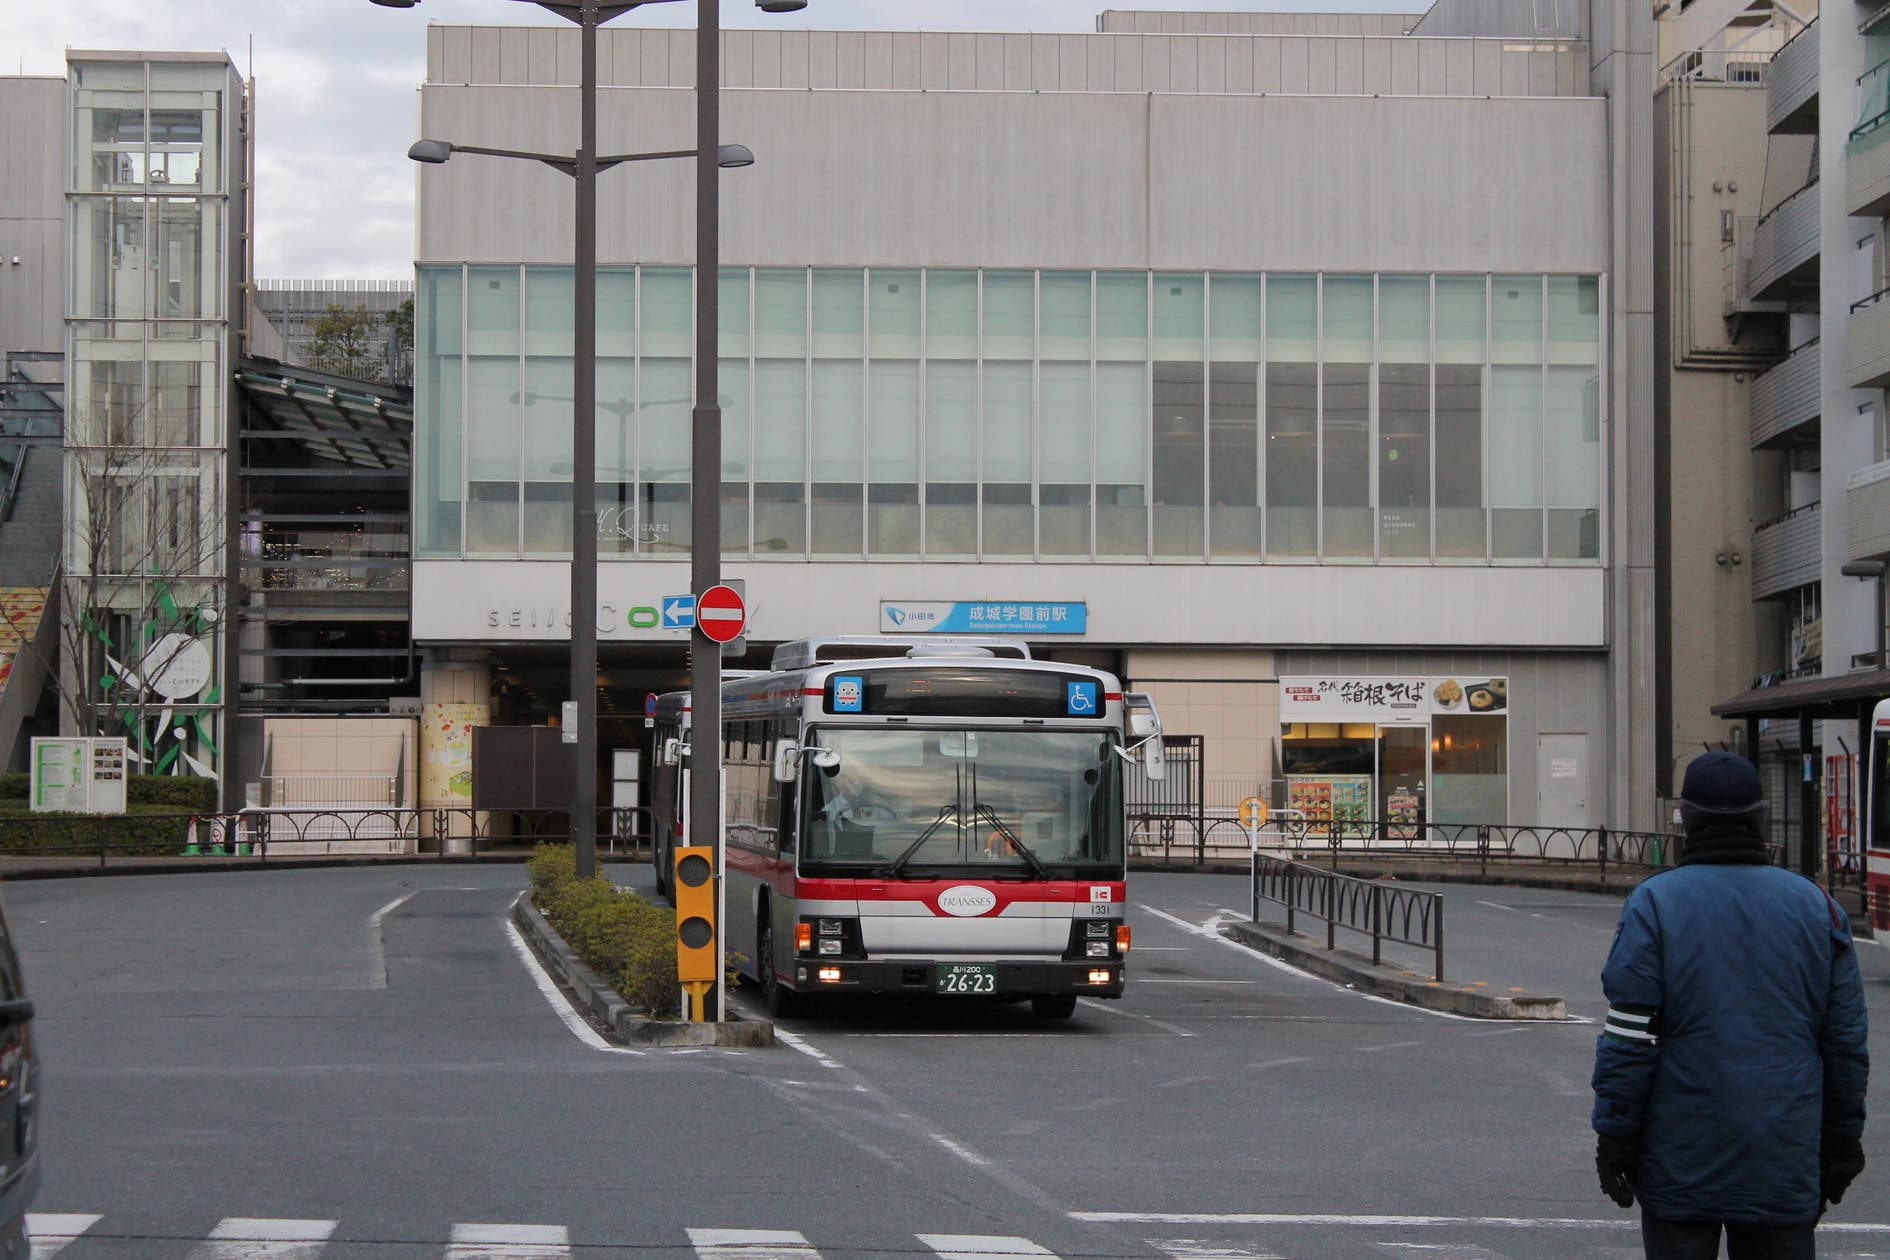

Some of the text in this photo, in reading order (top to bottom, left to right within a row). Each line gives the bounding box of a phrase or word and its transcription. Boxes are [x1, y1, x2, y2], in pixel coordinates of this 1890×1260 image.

[640, 523, 669, 532] CAFE
[596, 603, 761, 634] COY
[908, 612, 936, 621] 小田急
[969, 606, 1068, 621] 成城学園前駅
[1340, 681, 1426, 706] 箱根そば
[943, 896, 992, 907] TRANSSES
[1091, 905, 1110, 915] 1331
[947, 974, 995, 992] 26-23
